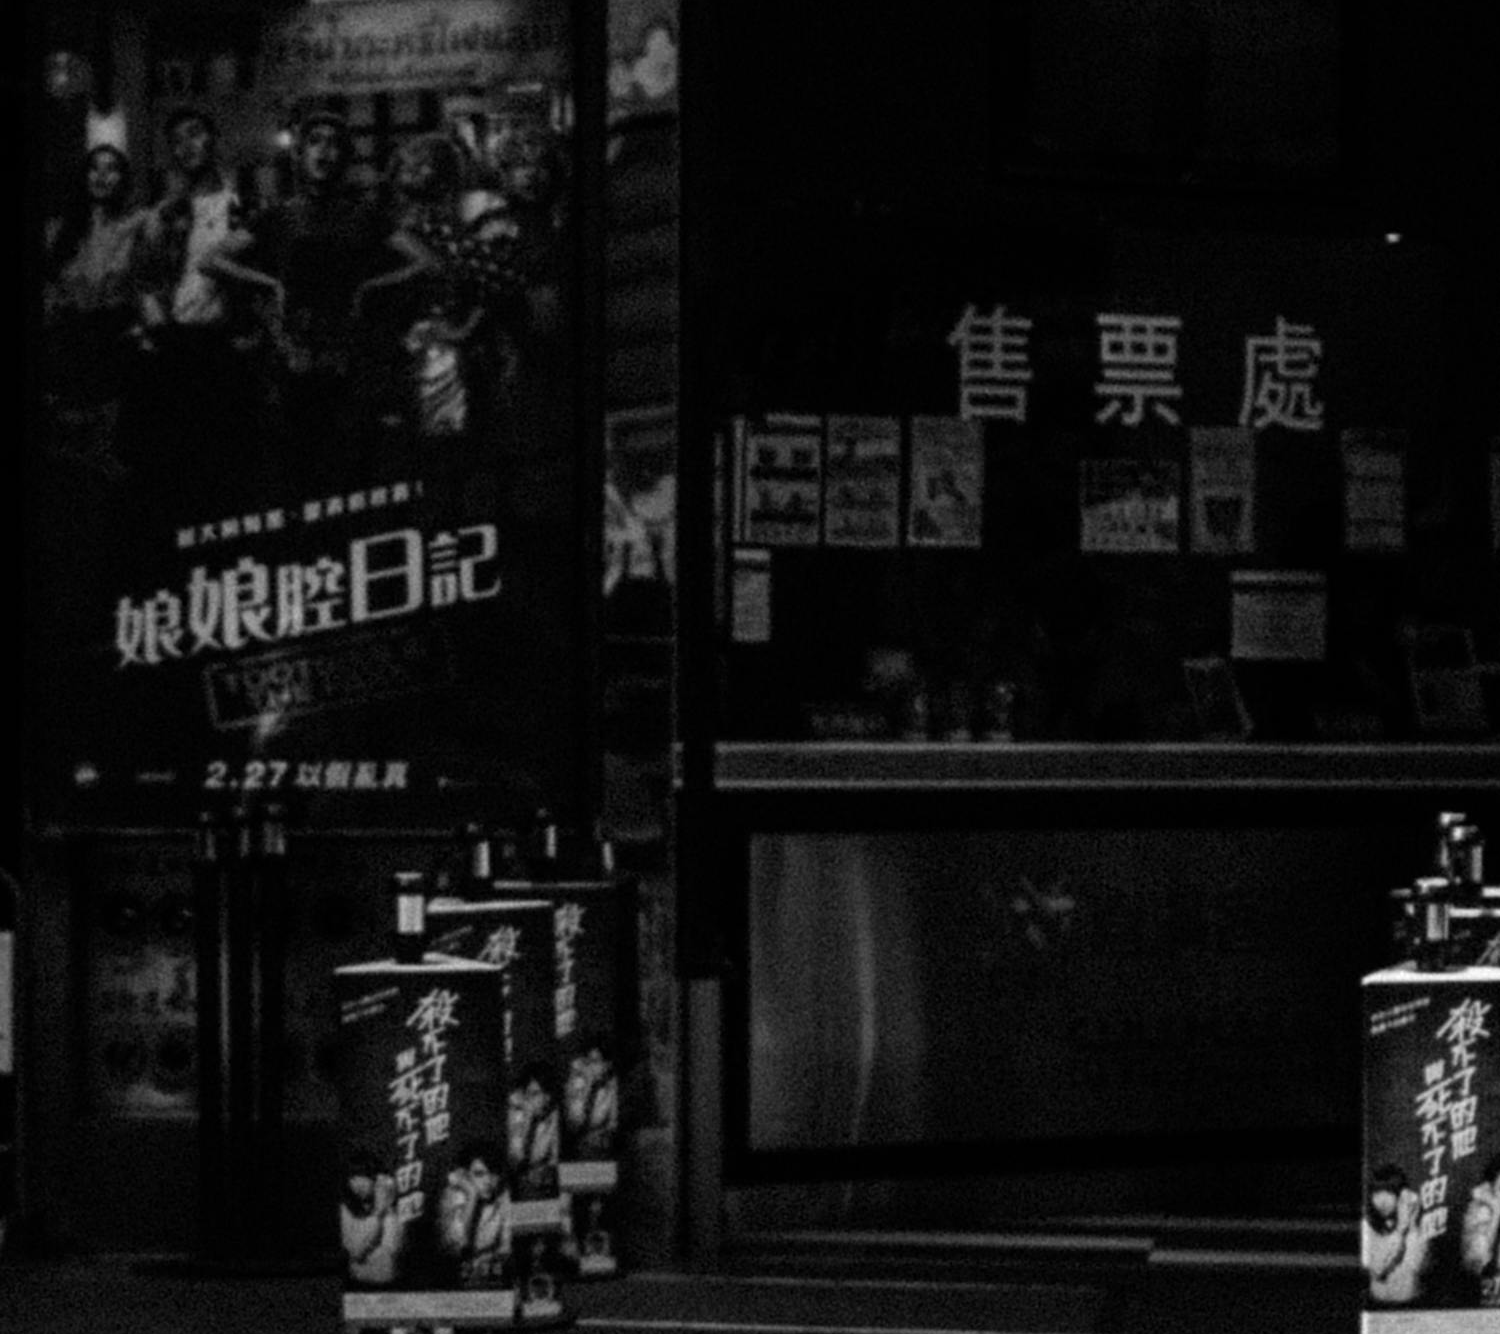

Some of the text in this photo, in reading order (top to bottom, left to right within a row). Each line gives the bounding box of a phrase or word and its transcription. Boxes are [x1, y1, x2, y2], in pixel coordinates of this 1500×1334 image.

[948, 302, 1325, 432] 售票處
[114, 522, 502, 669] 娘娘腔日記
